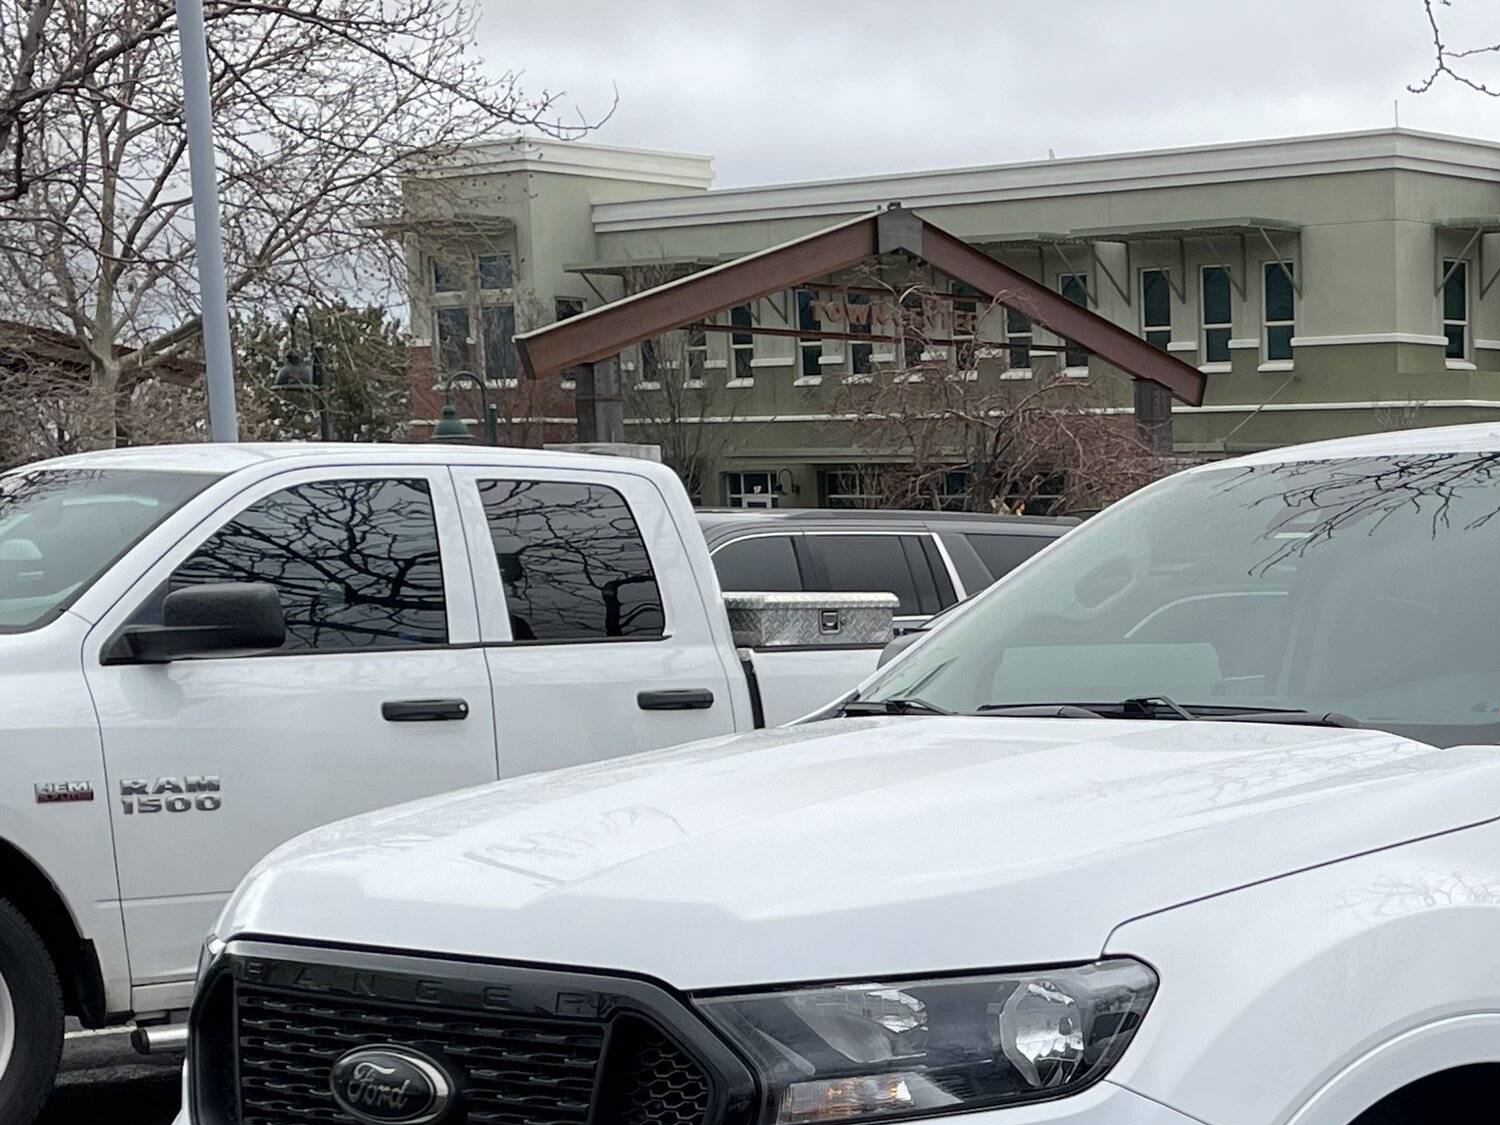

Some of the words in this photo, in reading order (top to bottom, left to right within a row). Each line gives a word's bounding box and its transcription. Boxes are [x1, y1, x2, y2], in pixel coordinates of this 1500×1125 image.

[119, 775, 221, 795] RAM
[120, 794, 221, 815] 1500
[346, 1061, 411, 1109] Ford
